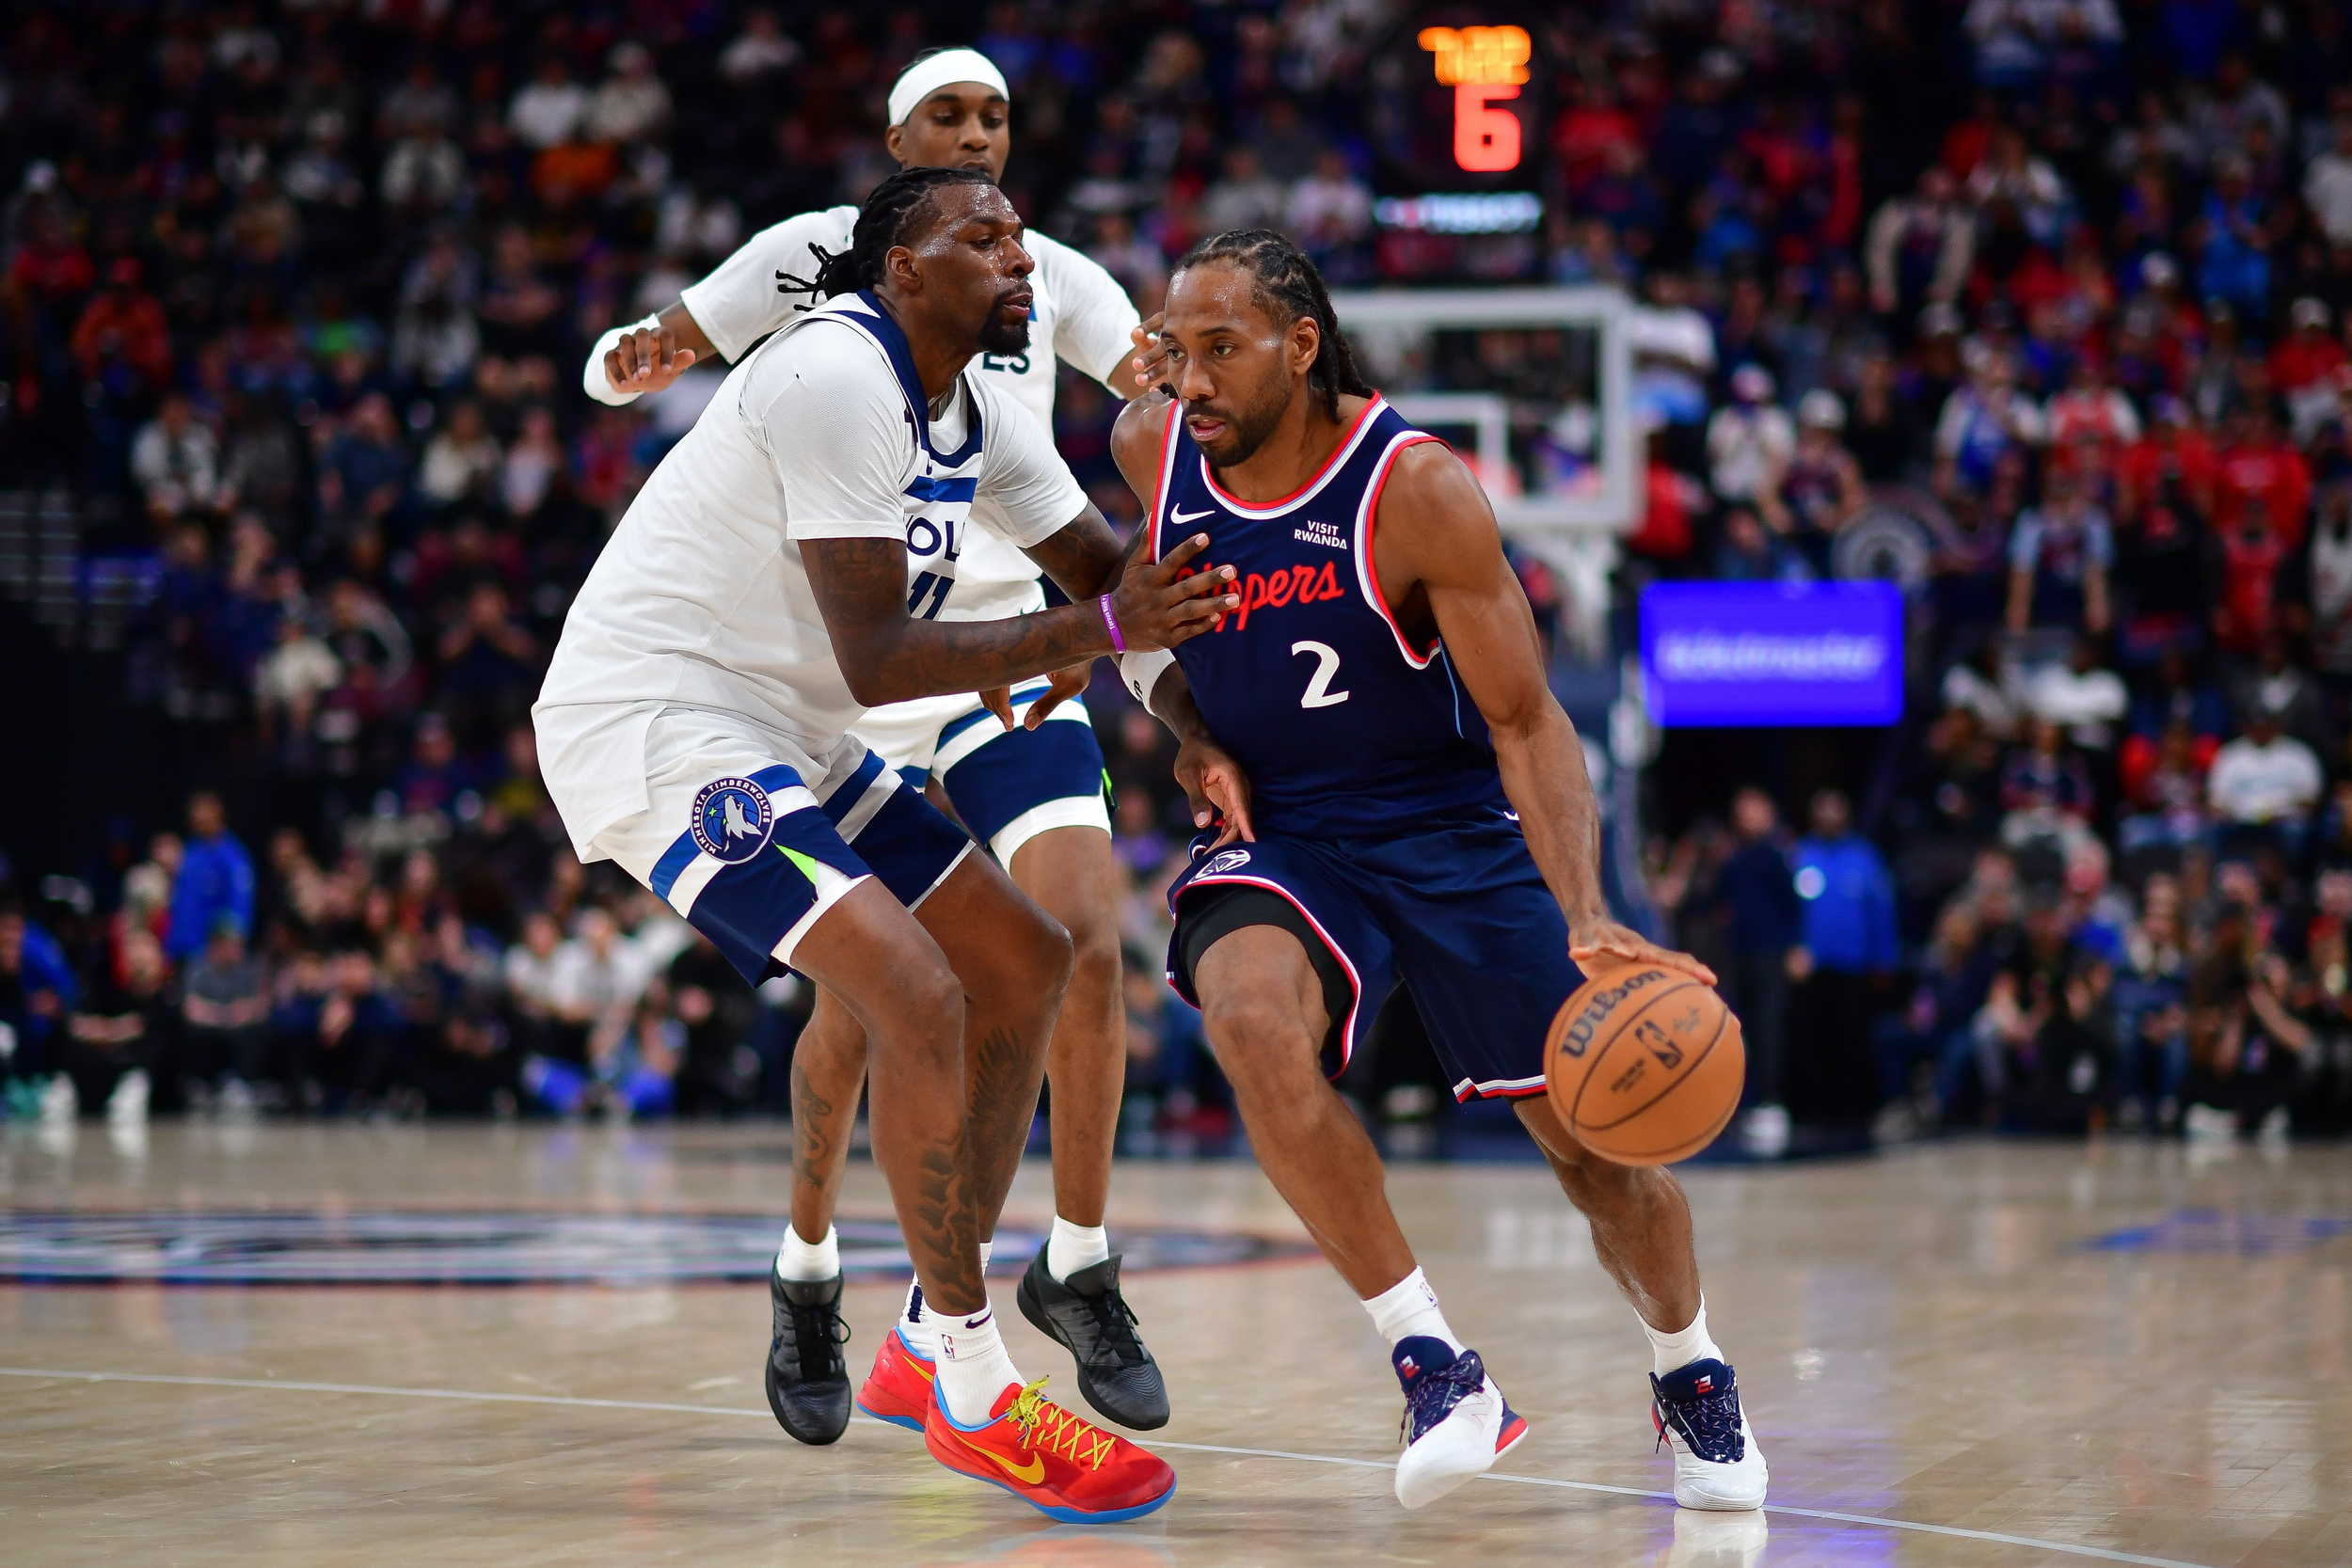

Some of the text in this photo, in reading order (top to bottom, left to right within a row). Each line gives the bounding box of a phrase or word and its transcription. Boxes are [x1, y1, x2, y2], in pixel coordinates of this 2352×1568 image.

[1454, 82, 1521, 172] 6
[1294, 529, 1347, 550] RWANDA
[1307, 520, 1339, 536] VISIT
[907, 570, 955, 621] 11
[1291, 641, 1349, 708] 2
[693, 779, 771, 855] MINNESOTA TIMBERWOLVES
[1561, 970, 1668, 1059] Wilson
